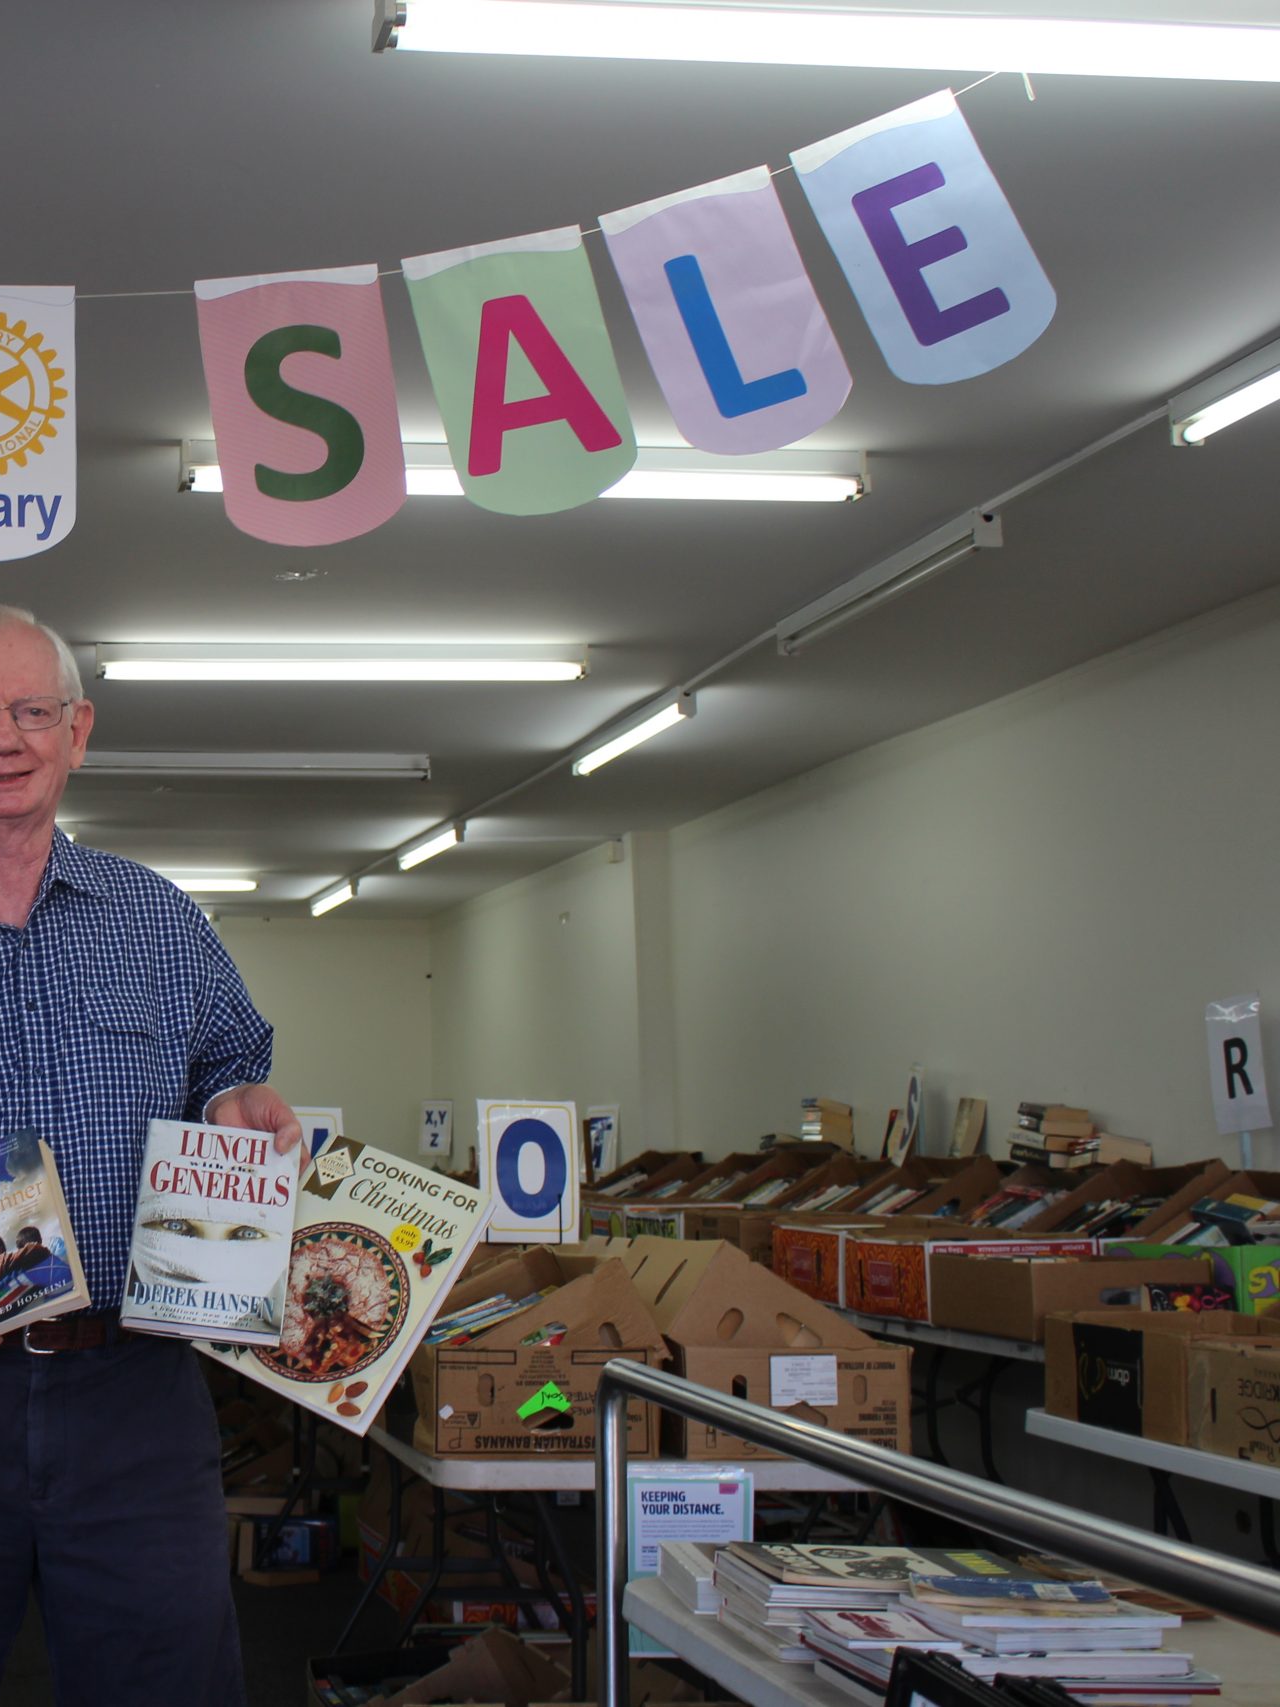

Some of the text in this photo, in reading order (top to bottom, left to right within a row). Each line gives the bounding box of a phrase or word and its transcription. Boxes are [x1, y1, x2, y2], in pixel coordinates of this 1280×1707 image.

[1223, 1037, 1254, 1099] R
[425, 1110, 447, 1127] X,Y
[179, 1129, 269, 1166] LUNCH
[430, 1133, 439, 1147] Z
[190, 1161, 223, 1171] with
[496, 1118, 567, 1218] O
[150, 1160, 290, 1207] GENERALS
[361, 1157, 479, 1213] COOKING FOR
[349, 1177, 459, 1240] Christmas
[16, 1279, 68, 1309] HOSSEINI
[133, 1281, 277, 1321] DEREK HANSEN
[475, 1434, 596, 1449] STRALIAN BANANAS
[641, 1490, 686, 1502] KEEPING
[642, 1503, 724, 1515] YOUR DISTANCE.
